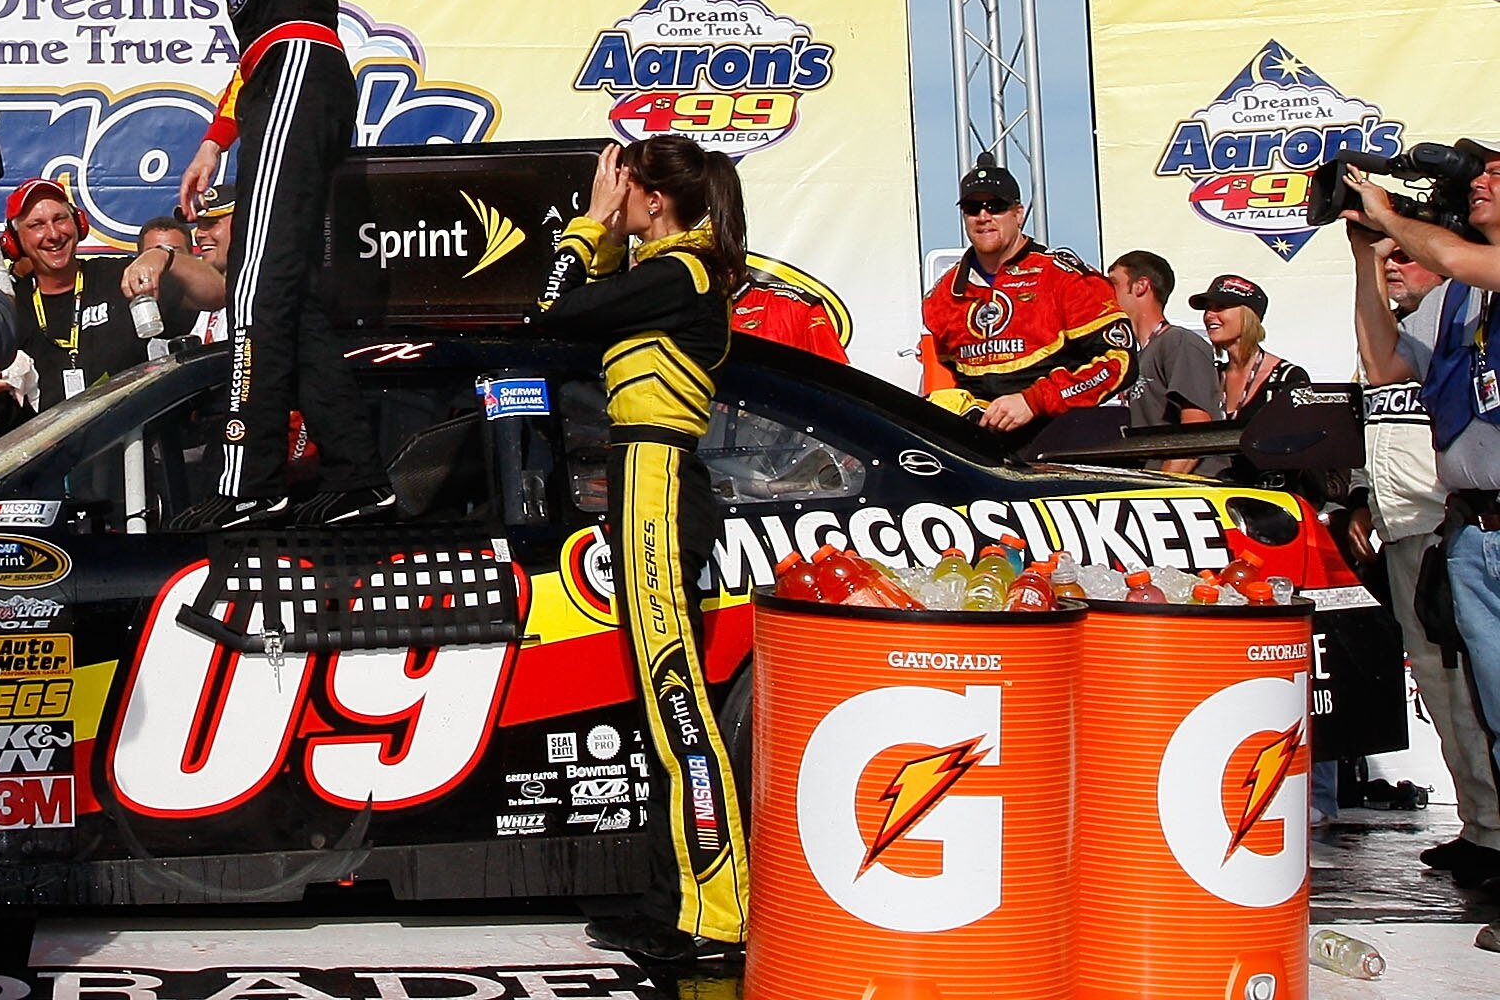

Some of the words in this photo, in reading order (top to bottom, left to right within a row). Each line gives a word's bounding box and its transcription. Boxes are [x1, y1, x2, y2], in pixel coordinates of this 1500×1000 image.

[668, 6, 749, 23] Dreams
[656, 23, 703, 37] Come
[703, 22, 742, 37] True
[742, 22, 763, 36] At
[85, 25, 193, 65] True
[200, 25, 241, 65] A
[576, 31, 835, 91] Aaron's
[1242, 95, 1320, 111] Dreams
[1232, 110, 1276, 124] Come
[1276, 108, 1314, 122] True
[1314, 106, 1334, 119] At
[1188, 172, 1316, 211] 49
[1226, 210, 1248, 221] AT
[1249, 208, 1309, 220] TALLAD
[358, 220, 468, 269] Sprint
[544, 253, 576, 300] Sprint
[230, 328, 247, 412] MICCOSUKEE
[1060, 367, 1111, 399] MICCOSUKEE
[500, 387, 542, 398] SHERWIN
[500, 396, 544, 406] WILLIAMS
[0, 504, 43, 515] NASCAR
[12, 516, 46, 524] CAR
[698, 497, 1230, 594] MICCOSUKEE
[644, 520, 659, 590] SERIES
[15, 604, 65, 619] LIGHT
[652, 594, 667, 634] CUP
[0, 638, 55, 657] Auto
[887, 650, 1002, 671] GATORADE
[668, 691, 700, 746] Sprint
[550, 736, 573, 748] SEAL
[594, 741, 615, 751] PRO
[566, 764, 627, 779] Bowman
[688, 757, 717, 822] NASCAR
[496, 814, 546, 829] WHIZZ
